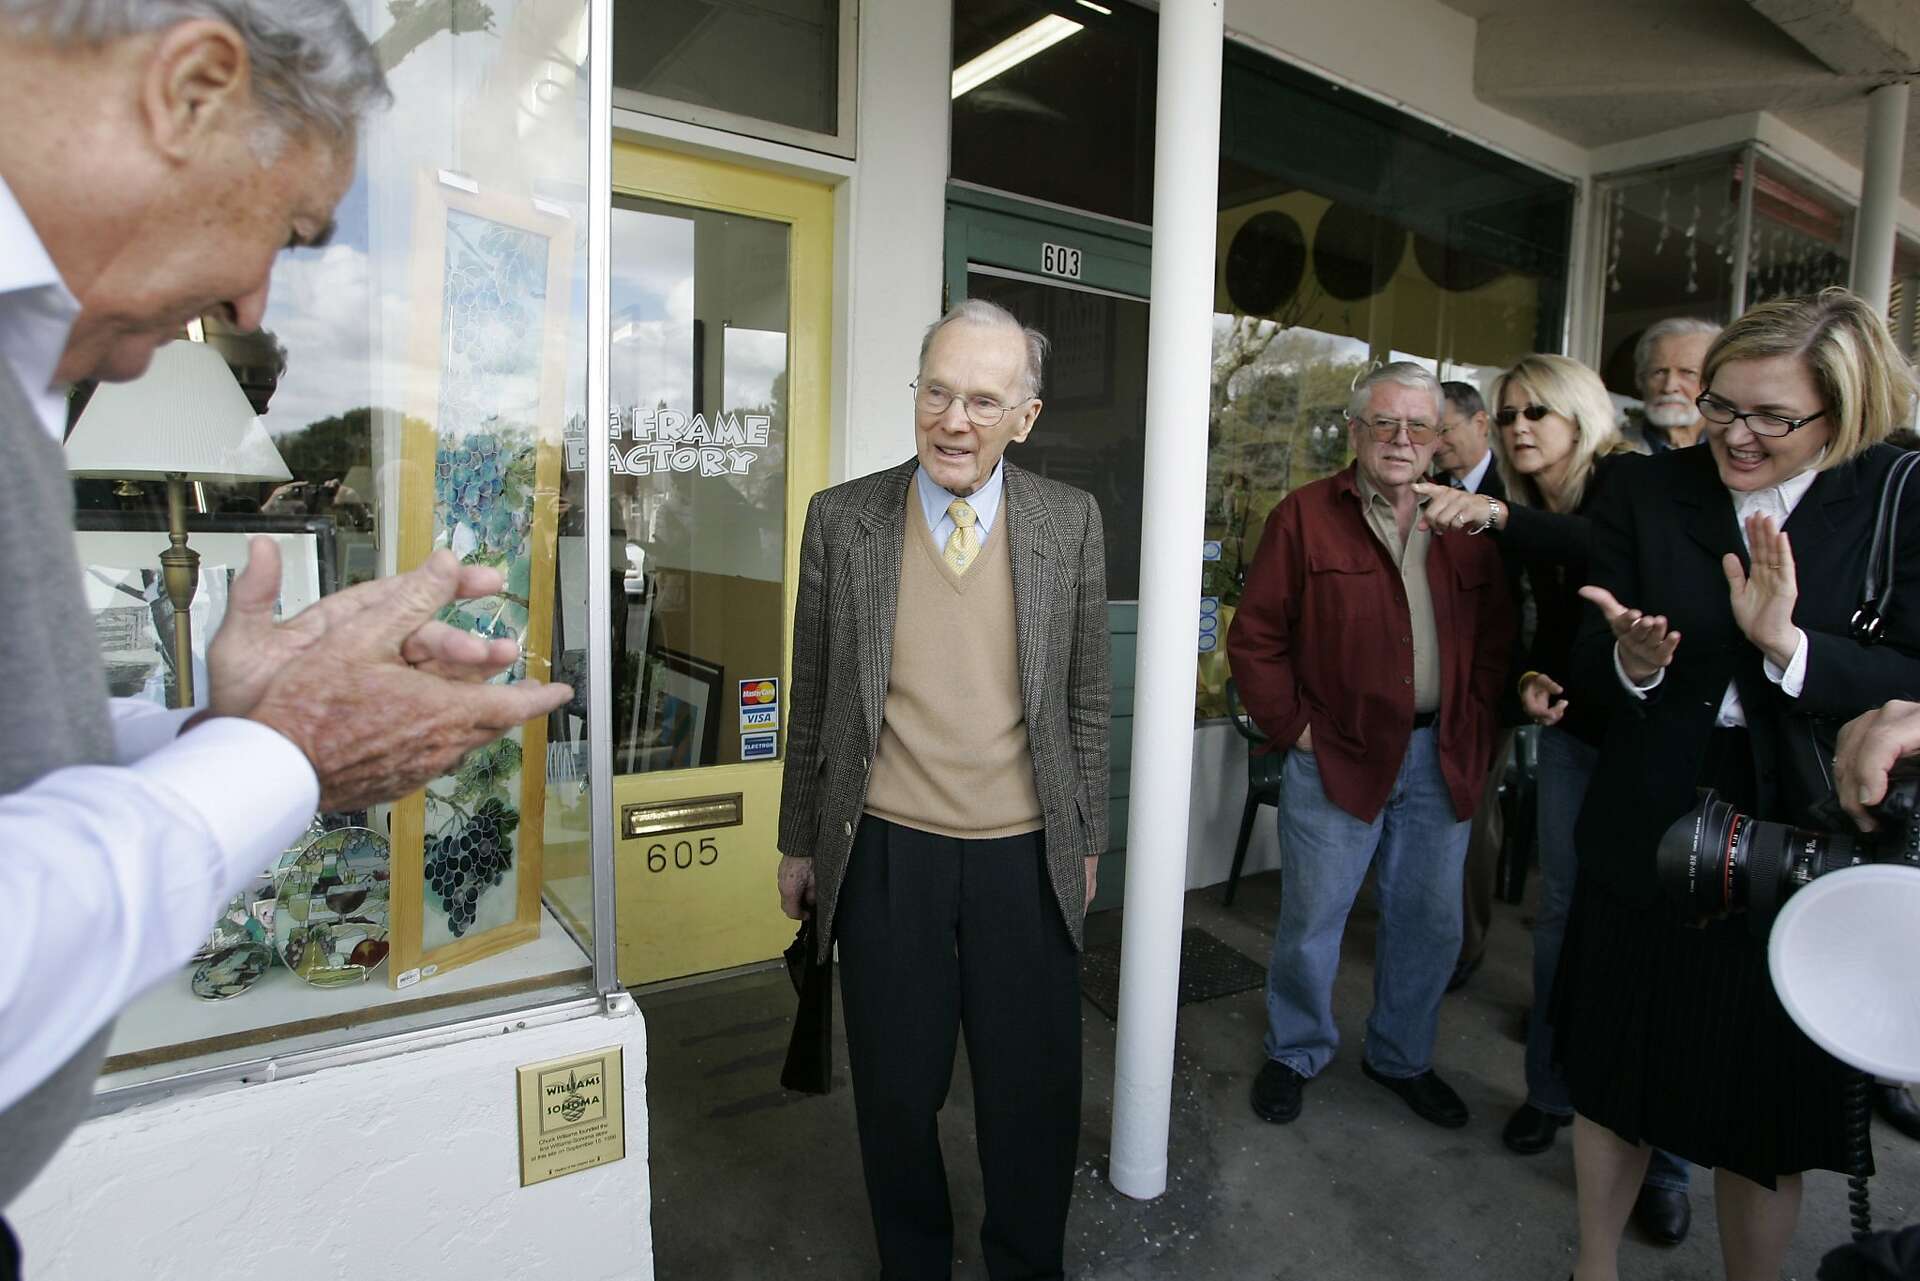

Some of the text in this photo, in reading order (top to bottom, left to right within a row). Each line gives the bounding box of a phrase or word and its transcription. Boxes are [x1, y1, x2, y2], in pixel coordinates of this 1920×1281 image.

[1043, 244, 1080, 277] 603
[633, 408, 771, 448] FRAME
[747, 712, 771, 724] VISA
[744, 742, 773, 751] ELECTRON
[647, 836, 719, 874] 605
[546, 1076, 600, 1096] WILLIAMS
[547, 1095, 600, 1115] SONOMA
